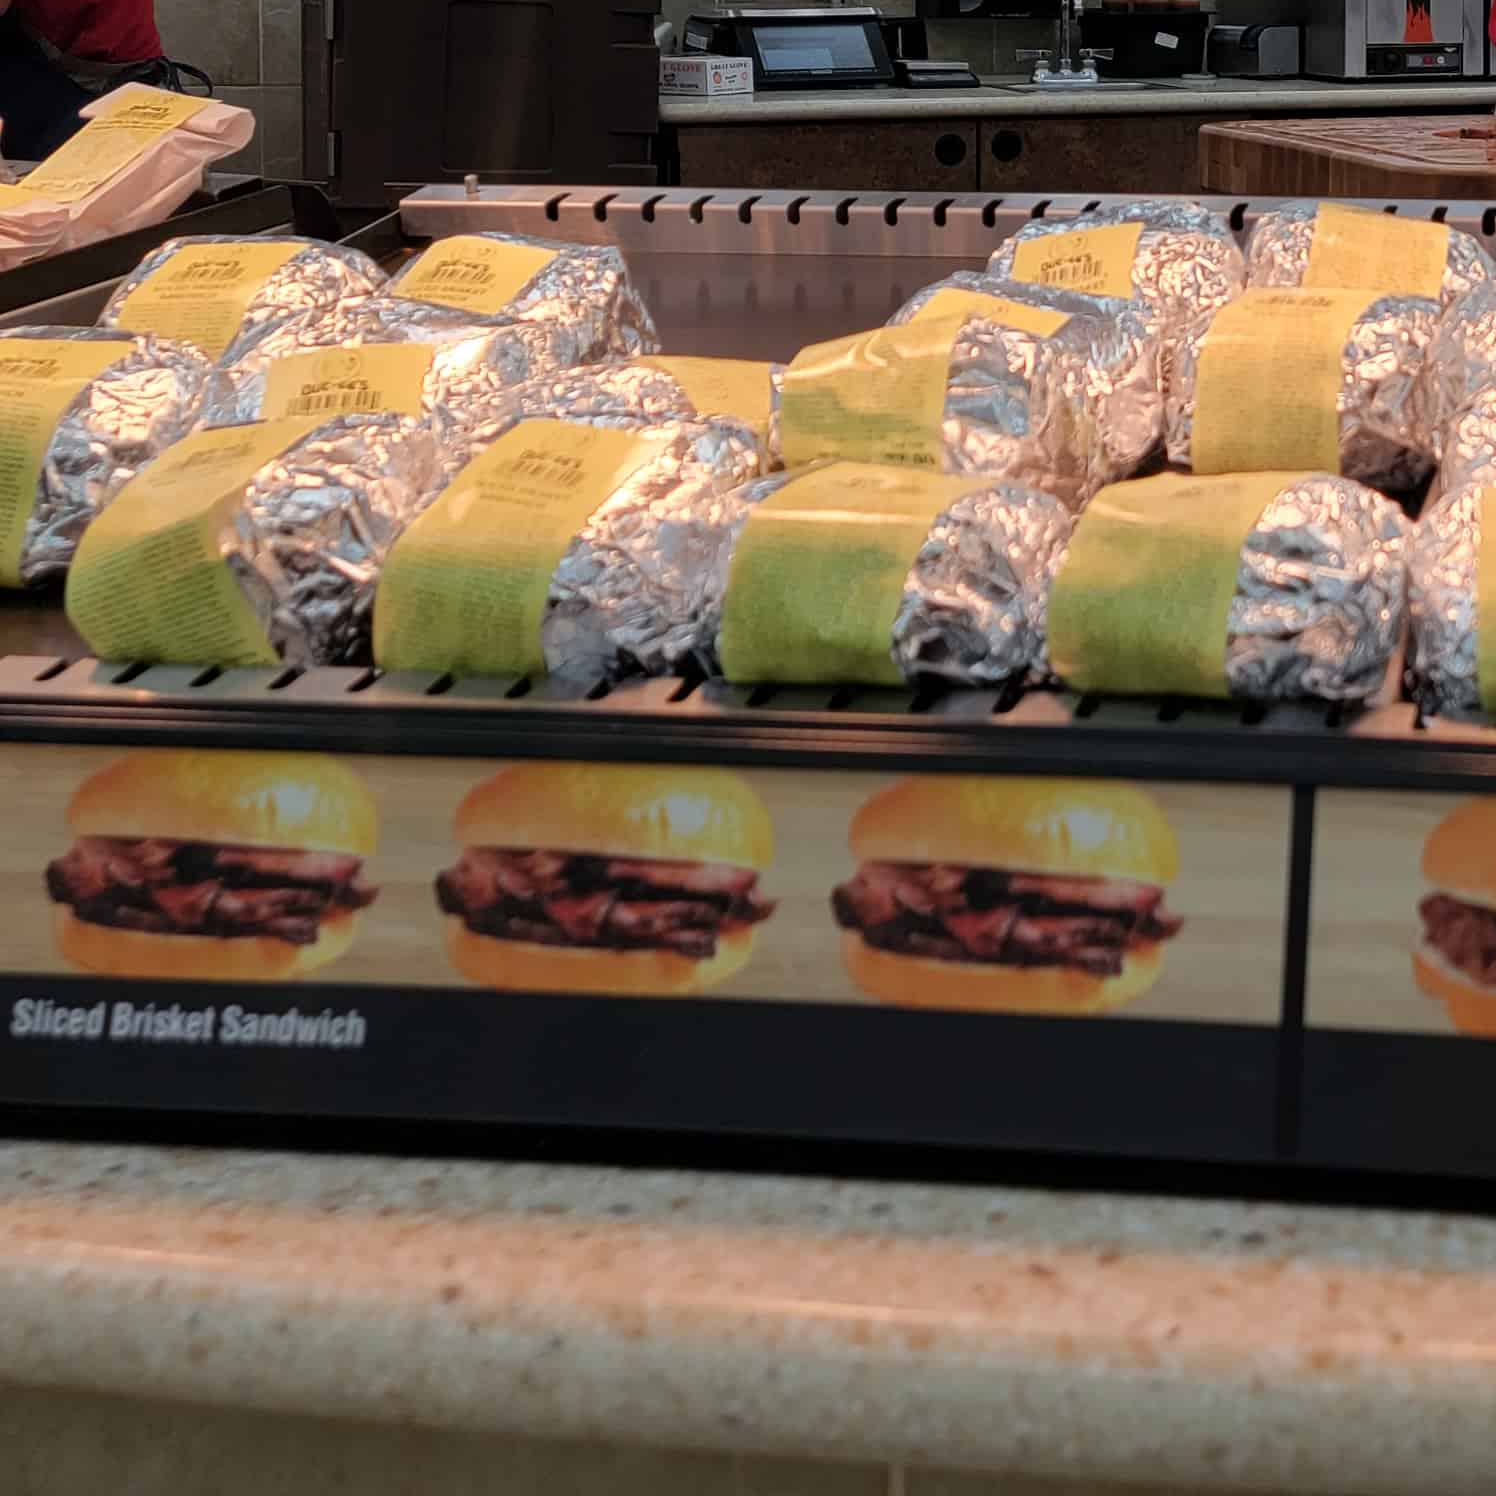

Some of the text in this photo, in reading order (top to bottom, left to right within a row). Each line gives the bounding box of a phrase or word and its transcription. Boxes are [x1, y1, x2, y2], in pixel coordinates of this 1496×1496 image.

[10, 997, 367, 1049] Sliced Brisket Sandwich
